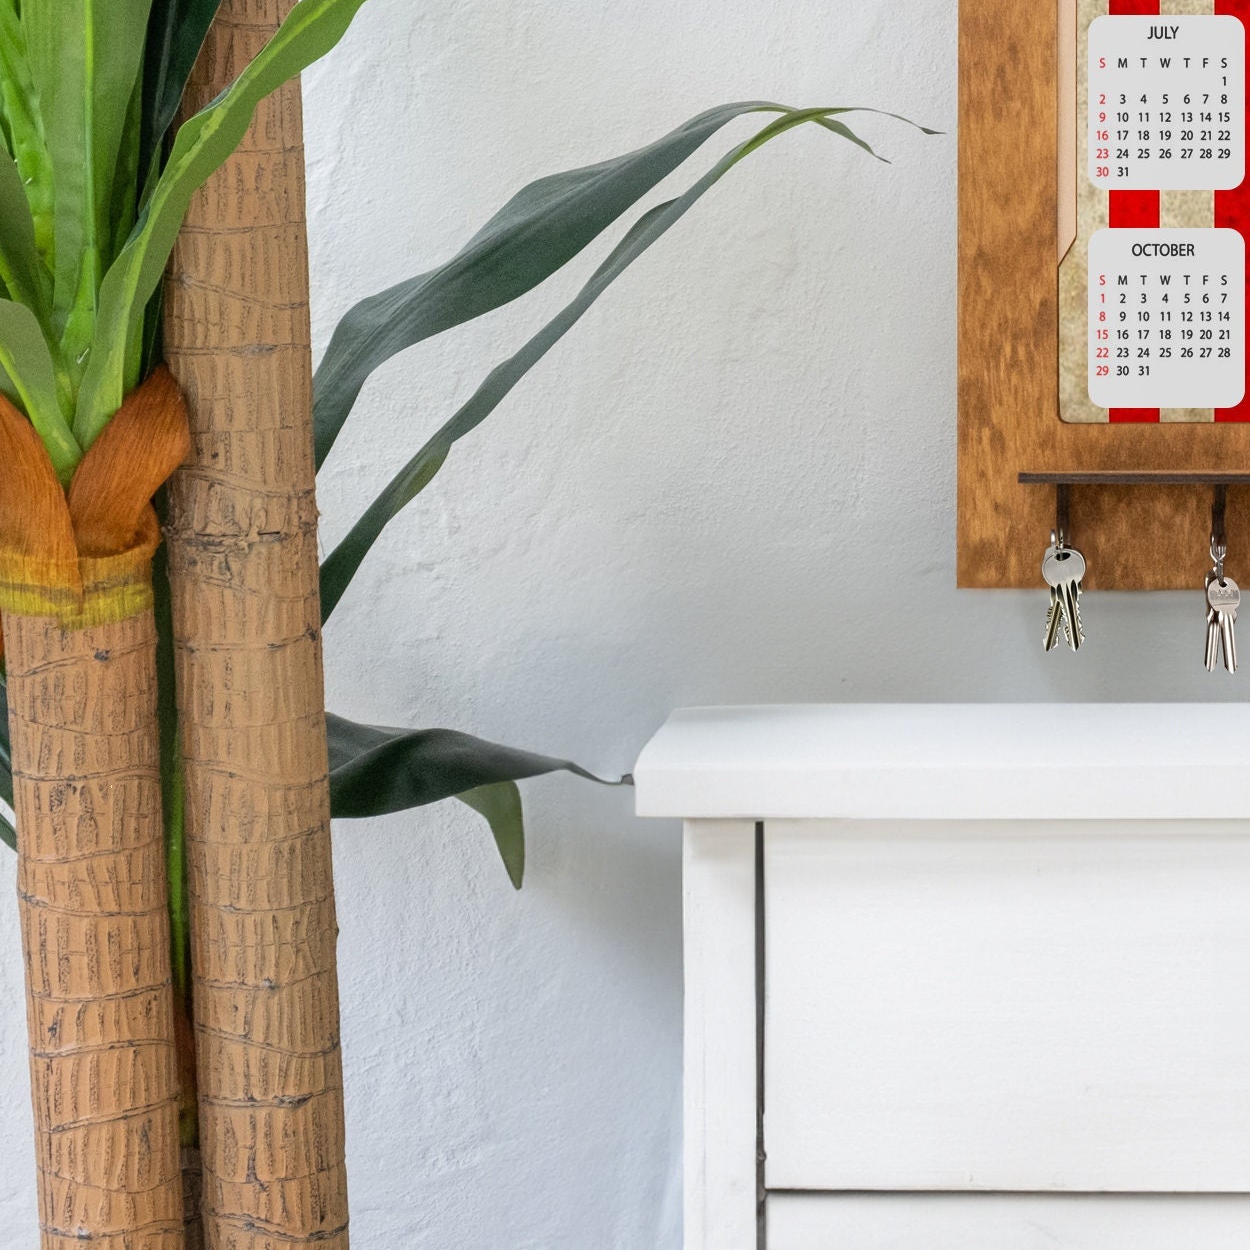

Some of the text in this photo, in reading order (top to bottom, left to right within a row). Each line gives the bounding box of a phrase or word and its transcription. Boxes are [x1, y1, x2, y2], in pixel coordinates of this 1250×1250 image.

[1147, 25, 1180, 40] JULY
[1096, 129, 1231, 141] 16 17 18 19 20 21 22
[1096, 166, 1129, 178] 30 31
[1131, 242, 1195, 257] OCTOBER
[1096, 329, 1230, 340] 15 16 17 18 19 20 21
[1095, 365, 1150, 377] 29 30 31
